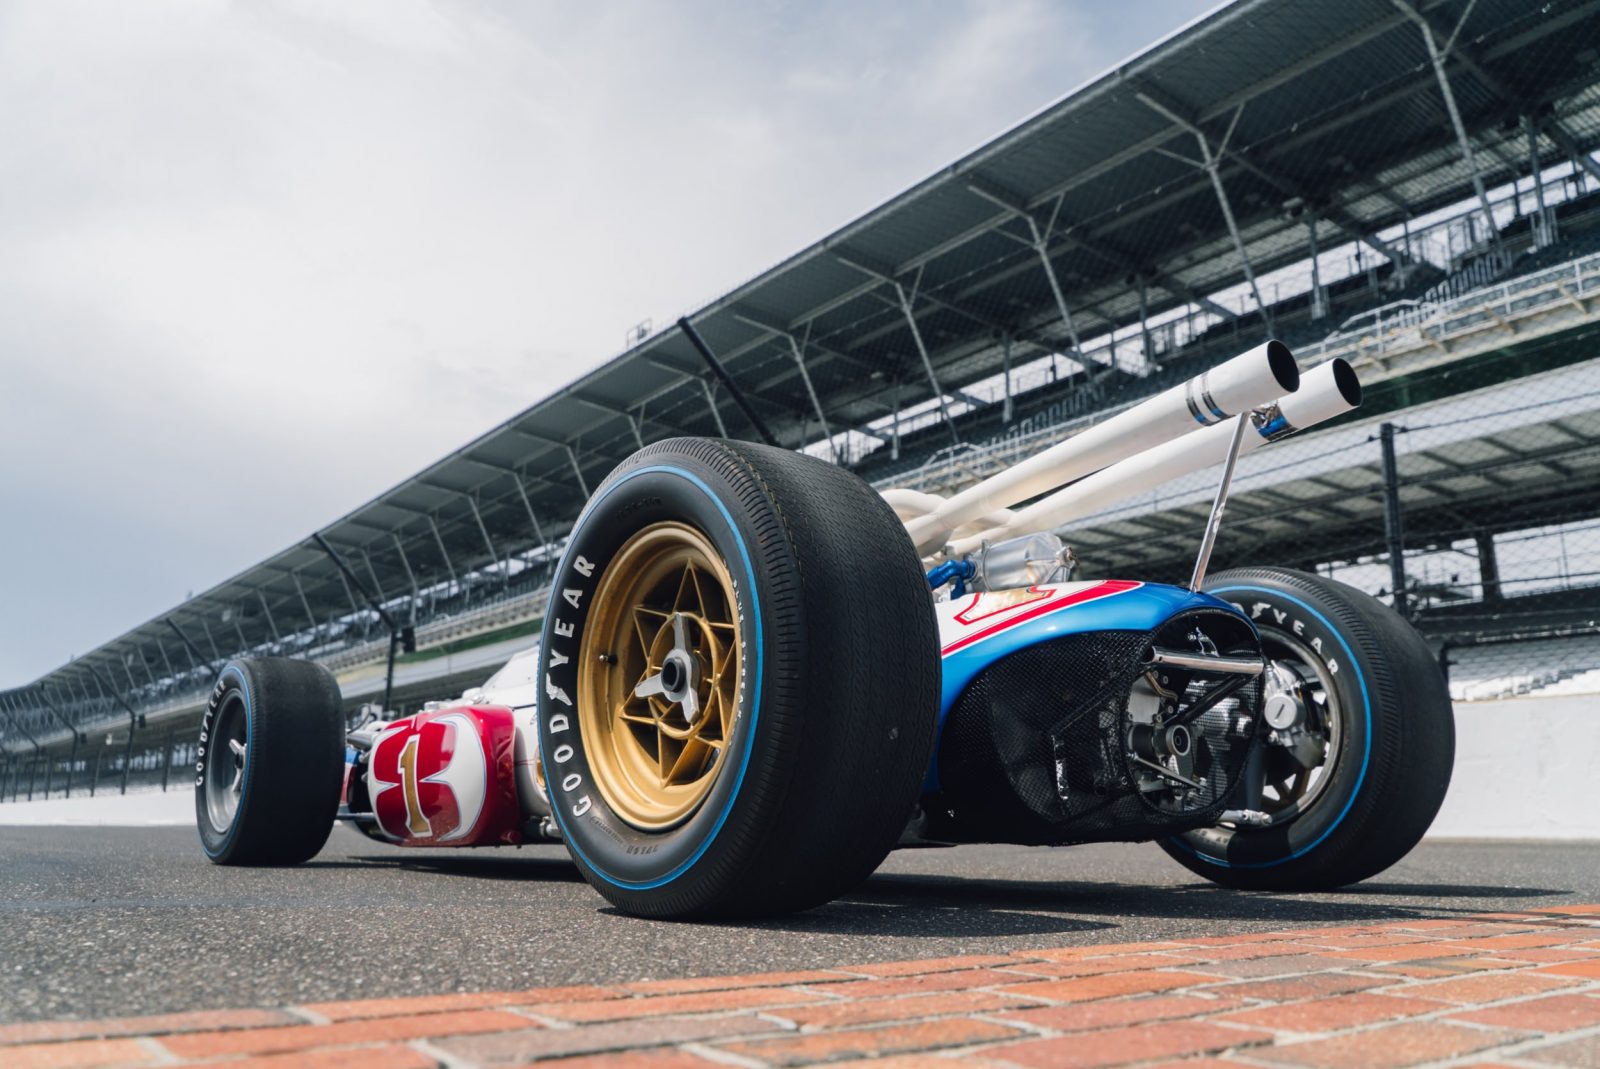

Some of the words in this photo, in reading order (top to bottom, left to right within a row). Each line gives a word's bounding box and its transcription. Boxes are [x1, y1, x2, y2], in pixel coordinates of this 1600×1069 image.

[195, 680, 226, 787] GOODYEAR
[546, 555, 595, 817] GOODYEAR
[397, 734, 433, 838] 1
